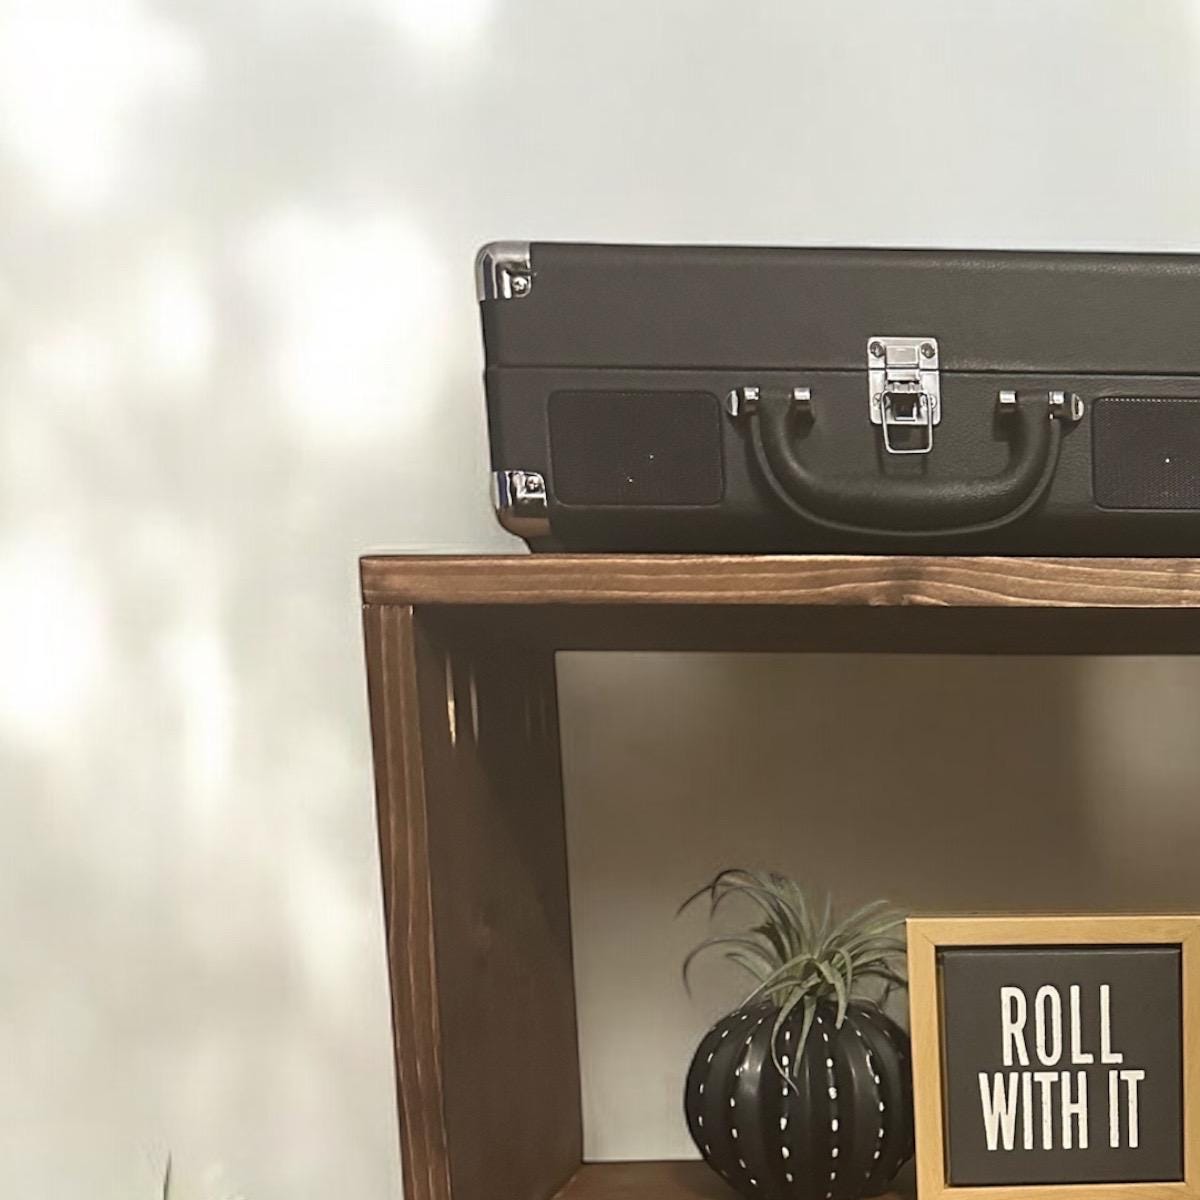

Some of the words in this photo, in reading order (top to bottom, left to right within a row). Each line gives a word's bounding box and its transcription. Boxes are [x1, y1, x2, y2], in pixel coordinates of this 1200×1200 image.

[1000, 984, 1124, 1067] ROLL
[978, 1070, 1089, 1151] WITH
[1108, 1069, 1146, 1149] IT
